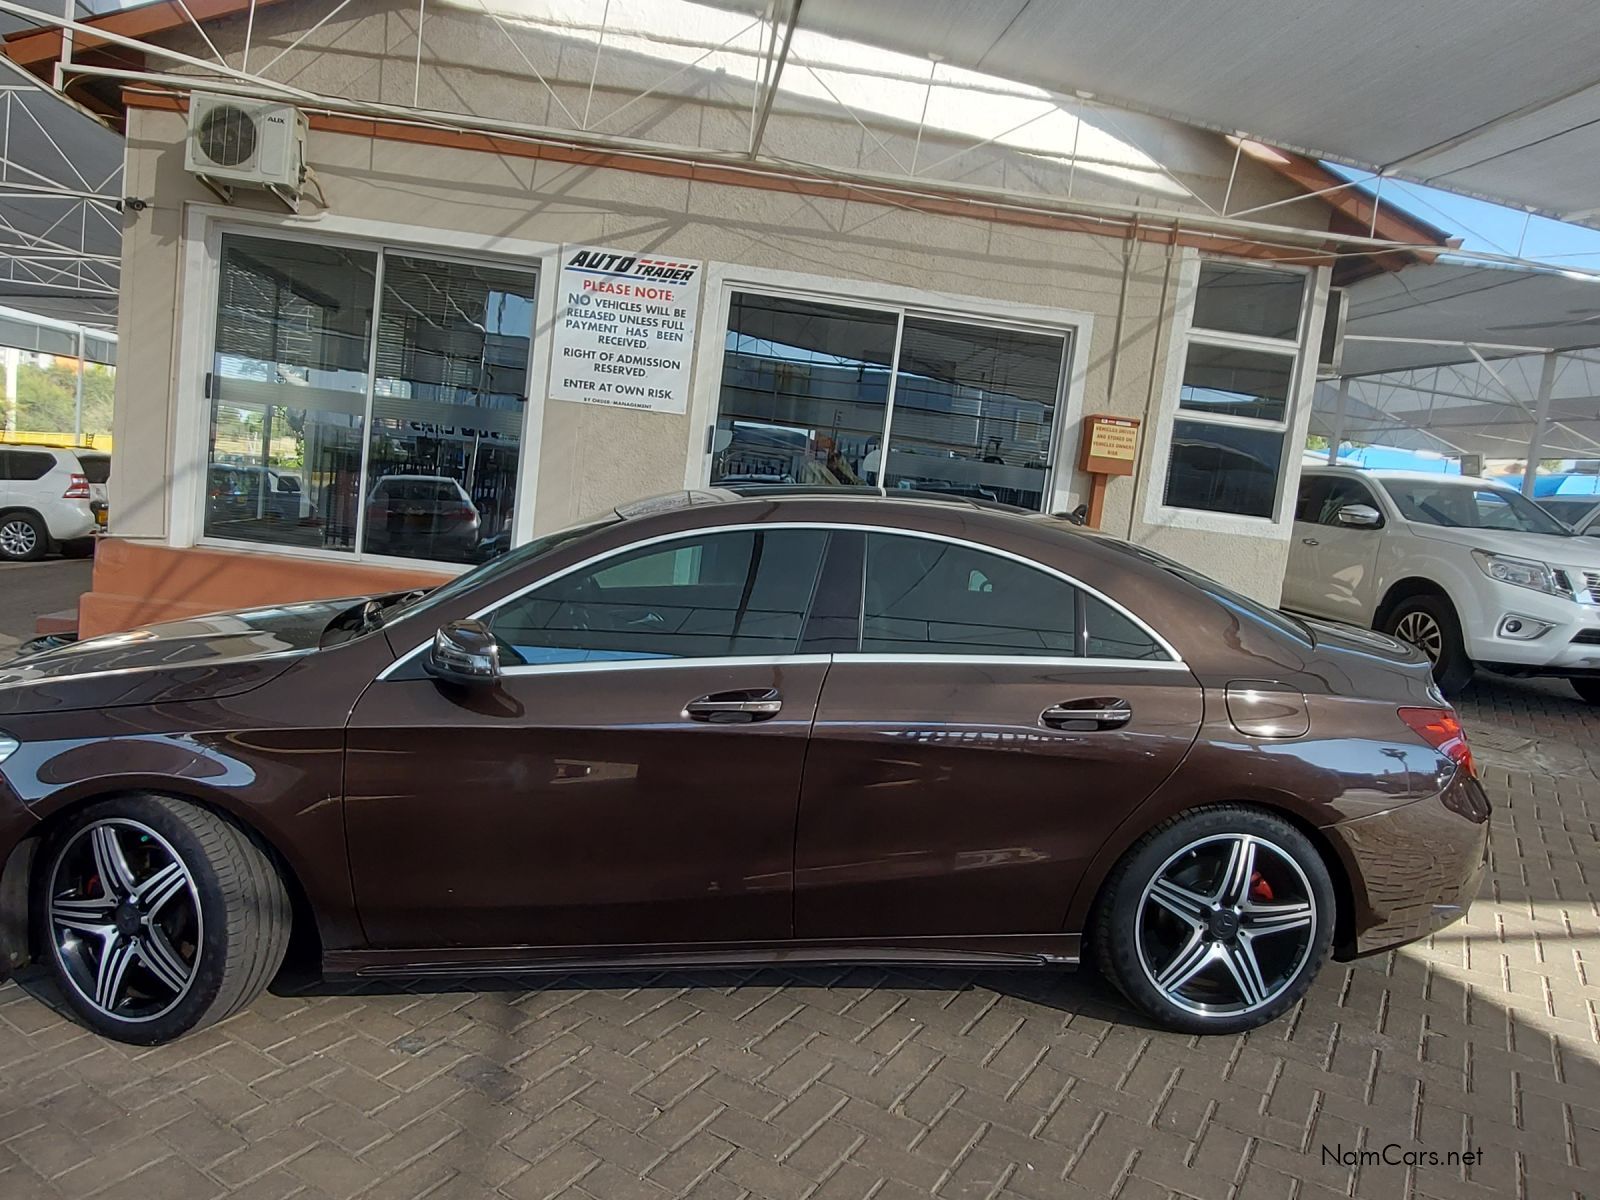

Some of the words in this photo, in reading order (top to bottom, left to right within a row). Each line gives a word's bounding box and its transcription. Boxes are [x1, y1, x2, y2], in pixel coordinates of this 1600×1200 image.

[267, 116, 285, 124] AUX
[568, 250, 637, 273] AUTO
[634, 264, 694, 281] TRADER
[583, 279, 631, 296] PLEASE
[635, 286, 675, 302] NOTE:
[568, 293, 591, 306] NO
[595, 298, 642, 313] VEHICLES
[645, 304, 671, 317] WILL
[673, 308, 687, 318] BE
[565, 319, 618, 334] PAYMENT
[626, 326, 649, 338] HAS
[656, 331, 683, 342] BEEN
[566, 308, 616, 322] RELEASED
[619, 314, 659, 328] UNLESS
[661, 320, 685, 331] FULL
[598, 335, 649, 350] RECEIVED.
[563, 347, 597, 360] RIGHT
[599, 352, 615, 361] OF
[616, 354, 681, 370] ADMISSION
[594, 362, 648, 378] RESERVED.
[563, 378, 596, 391] ENTER
[598, 383, 613, 392] AT
[615, 384, 645, 396] OWN
[647, 388, 674, 400] RISK.
[613, 400, 652, 409] MANAGEMENT
